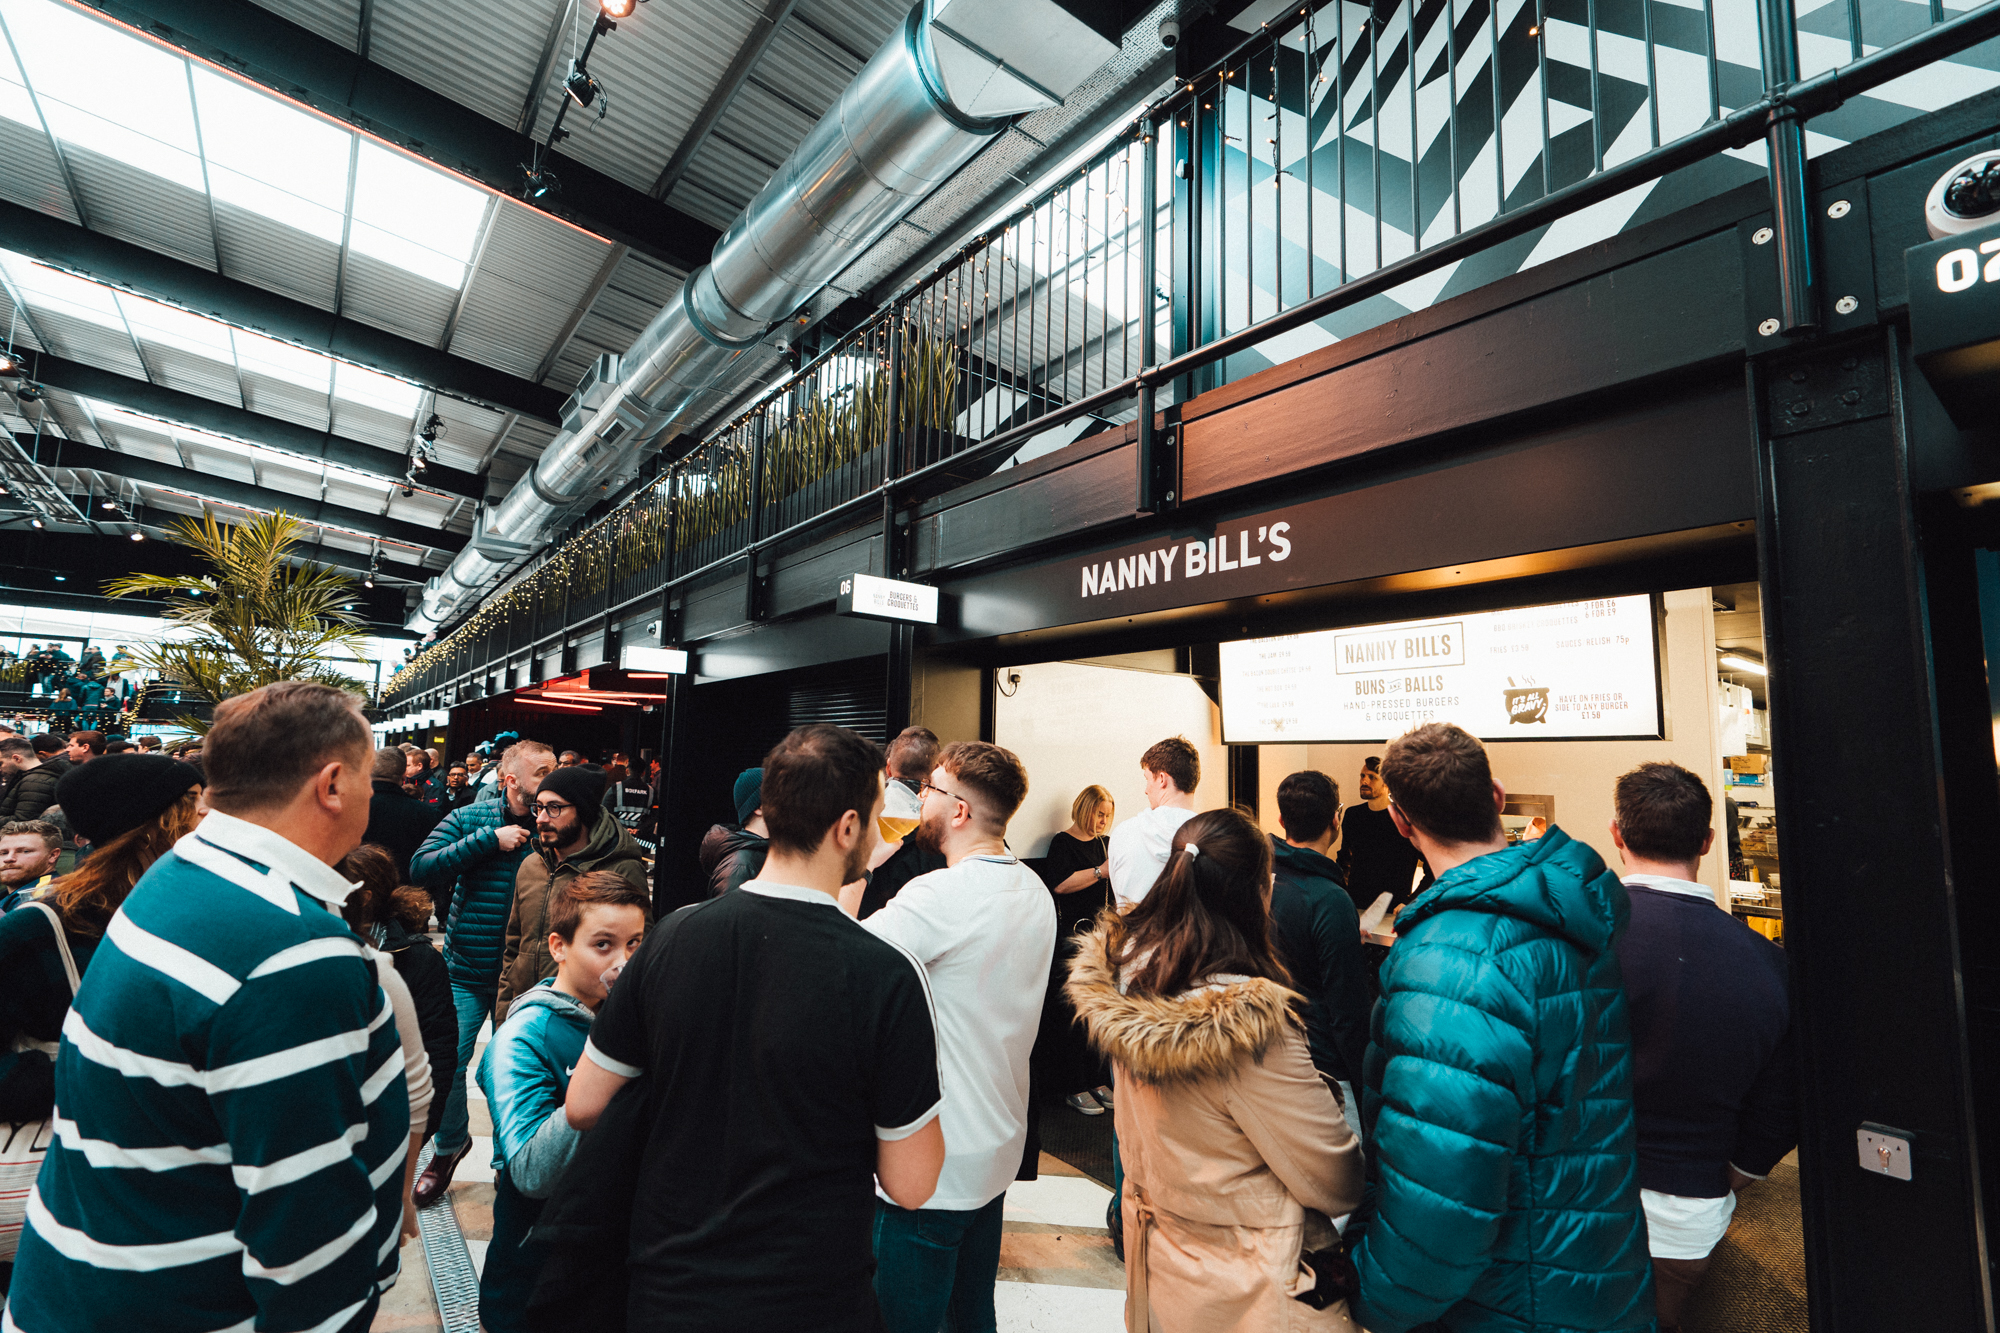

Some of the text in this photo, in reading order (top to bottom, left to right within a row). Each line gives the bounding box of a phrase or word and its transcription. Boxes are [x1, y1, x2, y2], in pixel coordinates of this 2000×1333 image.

[1081, 521, 1292, 598] NANNY BILL'S
[840, 579, 851, 595] 06
[889, 591, 912, 602] BURGERS
[887, 598, 919, 611] CROQUETTES
[1584, 602, 1589, 610] 3
[1591, 600, 1605, 609] FOR
[1606, 599, 1616, 609] £6
[1585, 607, 1617, 619] 6 FOR £9
[1493, 624, 1506, 632] BBQ
[1536, 615, 1578, 628] CROQUETTES
[1586, 636, 1611, 646] RELISH
[1616, 635, 1630, 645] 75p
[1345, 634, 1451, 664] NANNY BILL'S
[1489, 646, 1507, 654] FRIES
[1355, 674, 1443, 695] BUNS AND BALLS
[1526, 691, 1540, 702] ALL
[1558, 692, 1623, 703] HAVE ON FRIES OR
[1343, 696, 1460, 710] HAND-PRESSED BURGERS
[1511, 697, 1544, 715] GRAVY
[1554, 701, 1629, 712] SIDE TO ANY BURGER
[1365, 710, 1435, 722] & CROQUETTES
